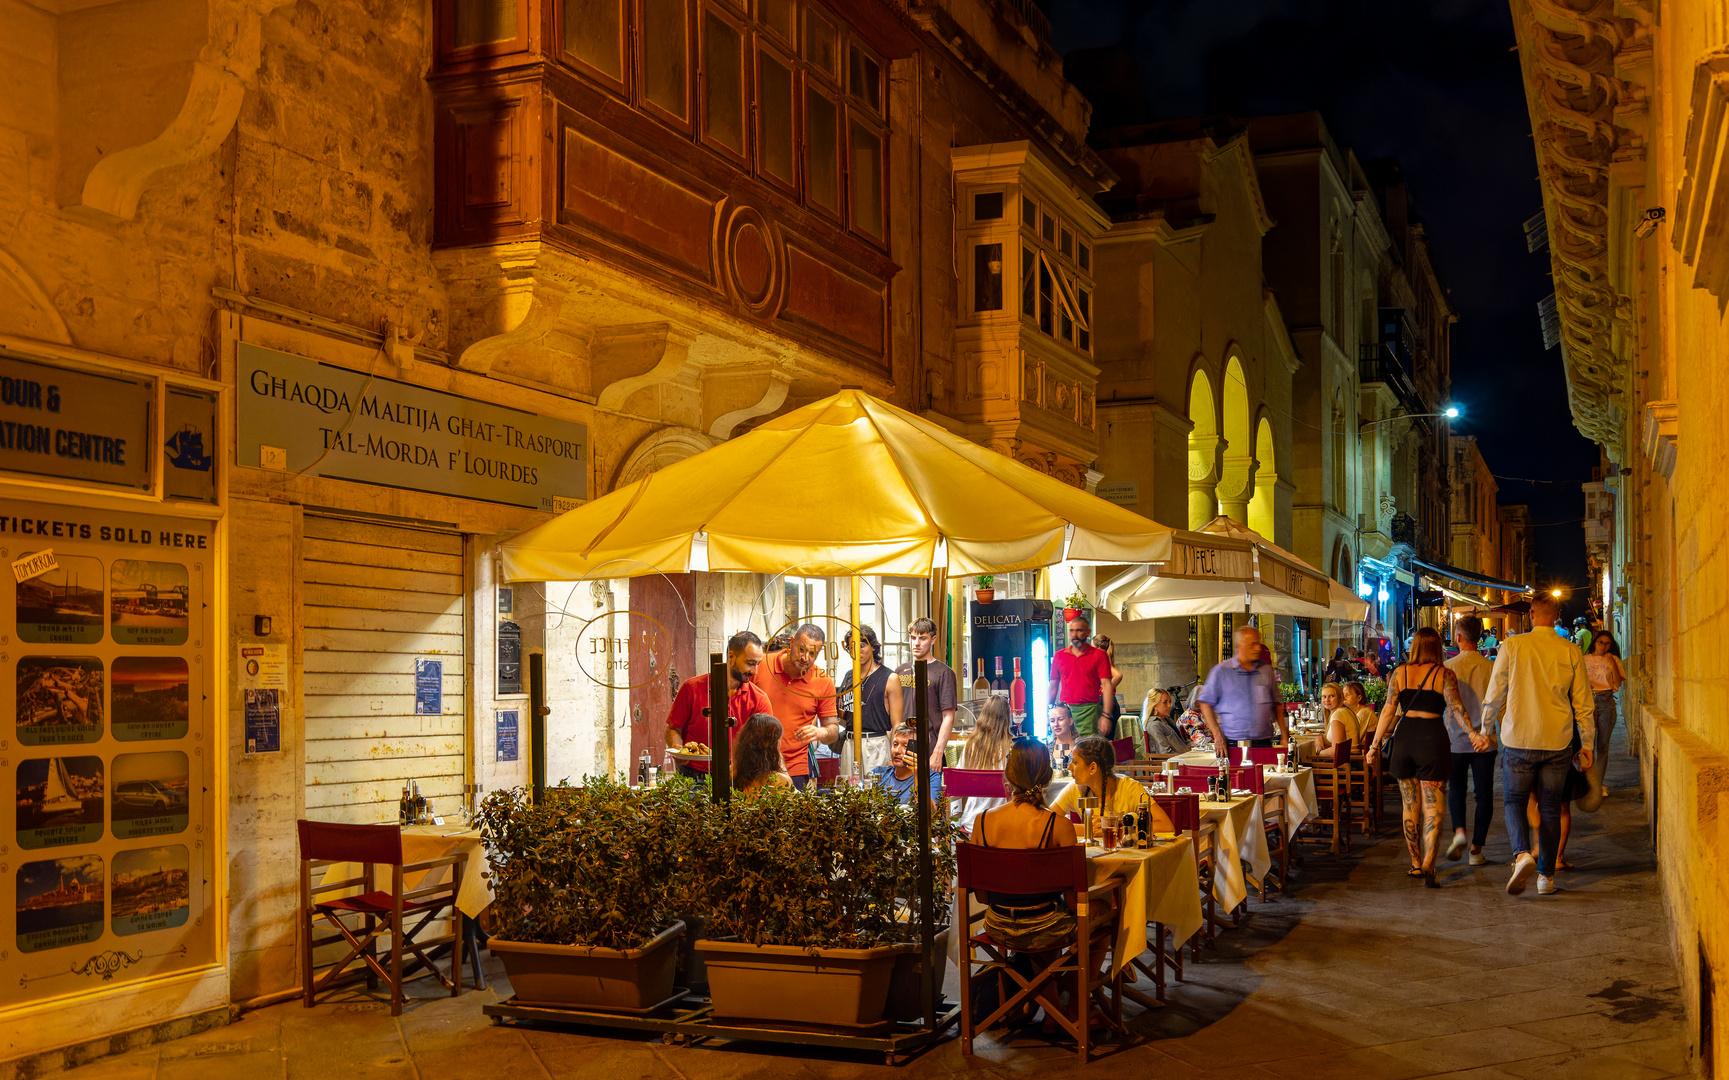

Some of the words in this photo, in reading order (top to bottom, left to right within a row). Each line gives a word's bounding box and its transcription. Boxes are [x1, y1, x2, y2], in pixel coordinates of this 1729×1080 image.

[0, 376, 42, 411] OUR
[46, 385, 60, 414] &
[360, 395, 441, 433] MALTIJA
[55, 429, 127, 467] CENTRE
[318, 427, 440, 469] TAL-MORDA
[0, 516, 92, 539] TICKETS
[99, 526, 152, 544] SOLD
[159, 531, 207, 549] HERE
[14, 551, 55, 579] TOMORROW
[974, 614, 1022, 626] DELICATA
